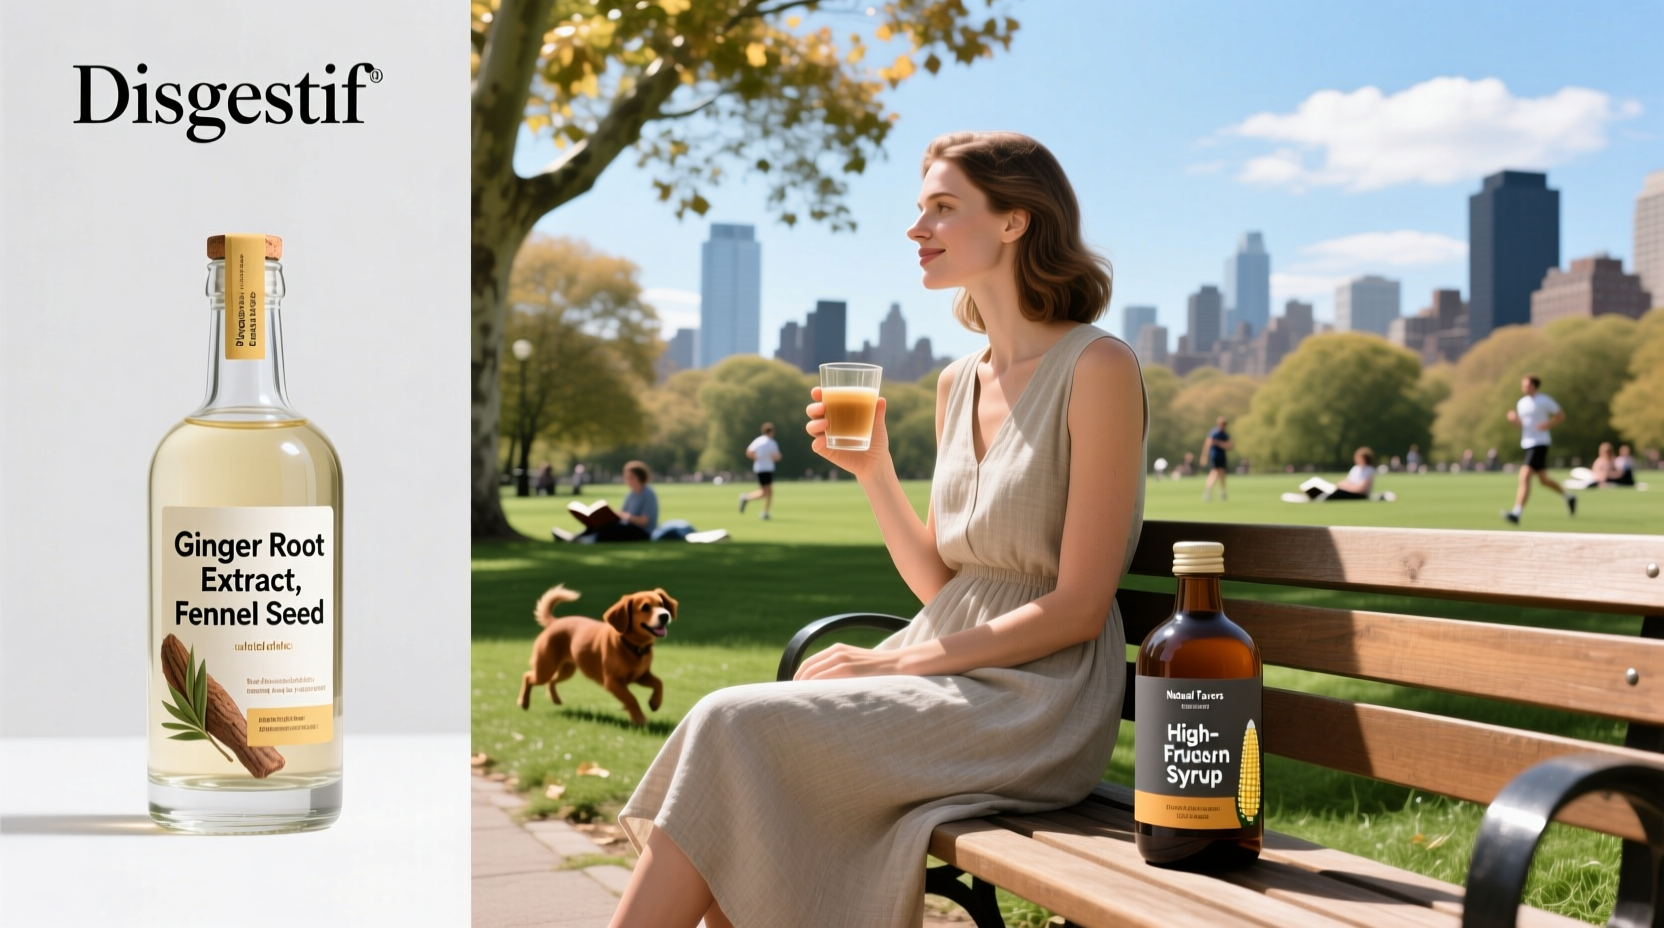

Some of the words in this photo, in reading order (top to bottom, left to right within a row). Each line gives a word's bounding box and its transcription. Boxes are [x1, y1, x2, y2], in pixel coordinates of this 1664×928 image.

[174, 530, 263, 564] Ginger
[269, 532, 325, 557] Root
[201, 566, 302, 596] Extract,
[175, 600, 258, 626] Fennel
[266, 598, 325, 626] Seed
[1167, 723, 1219, 747] High-
[1166, 765, 1223, 789] Syrup
